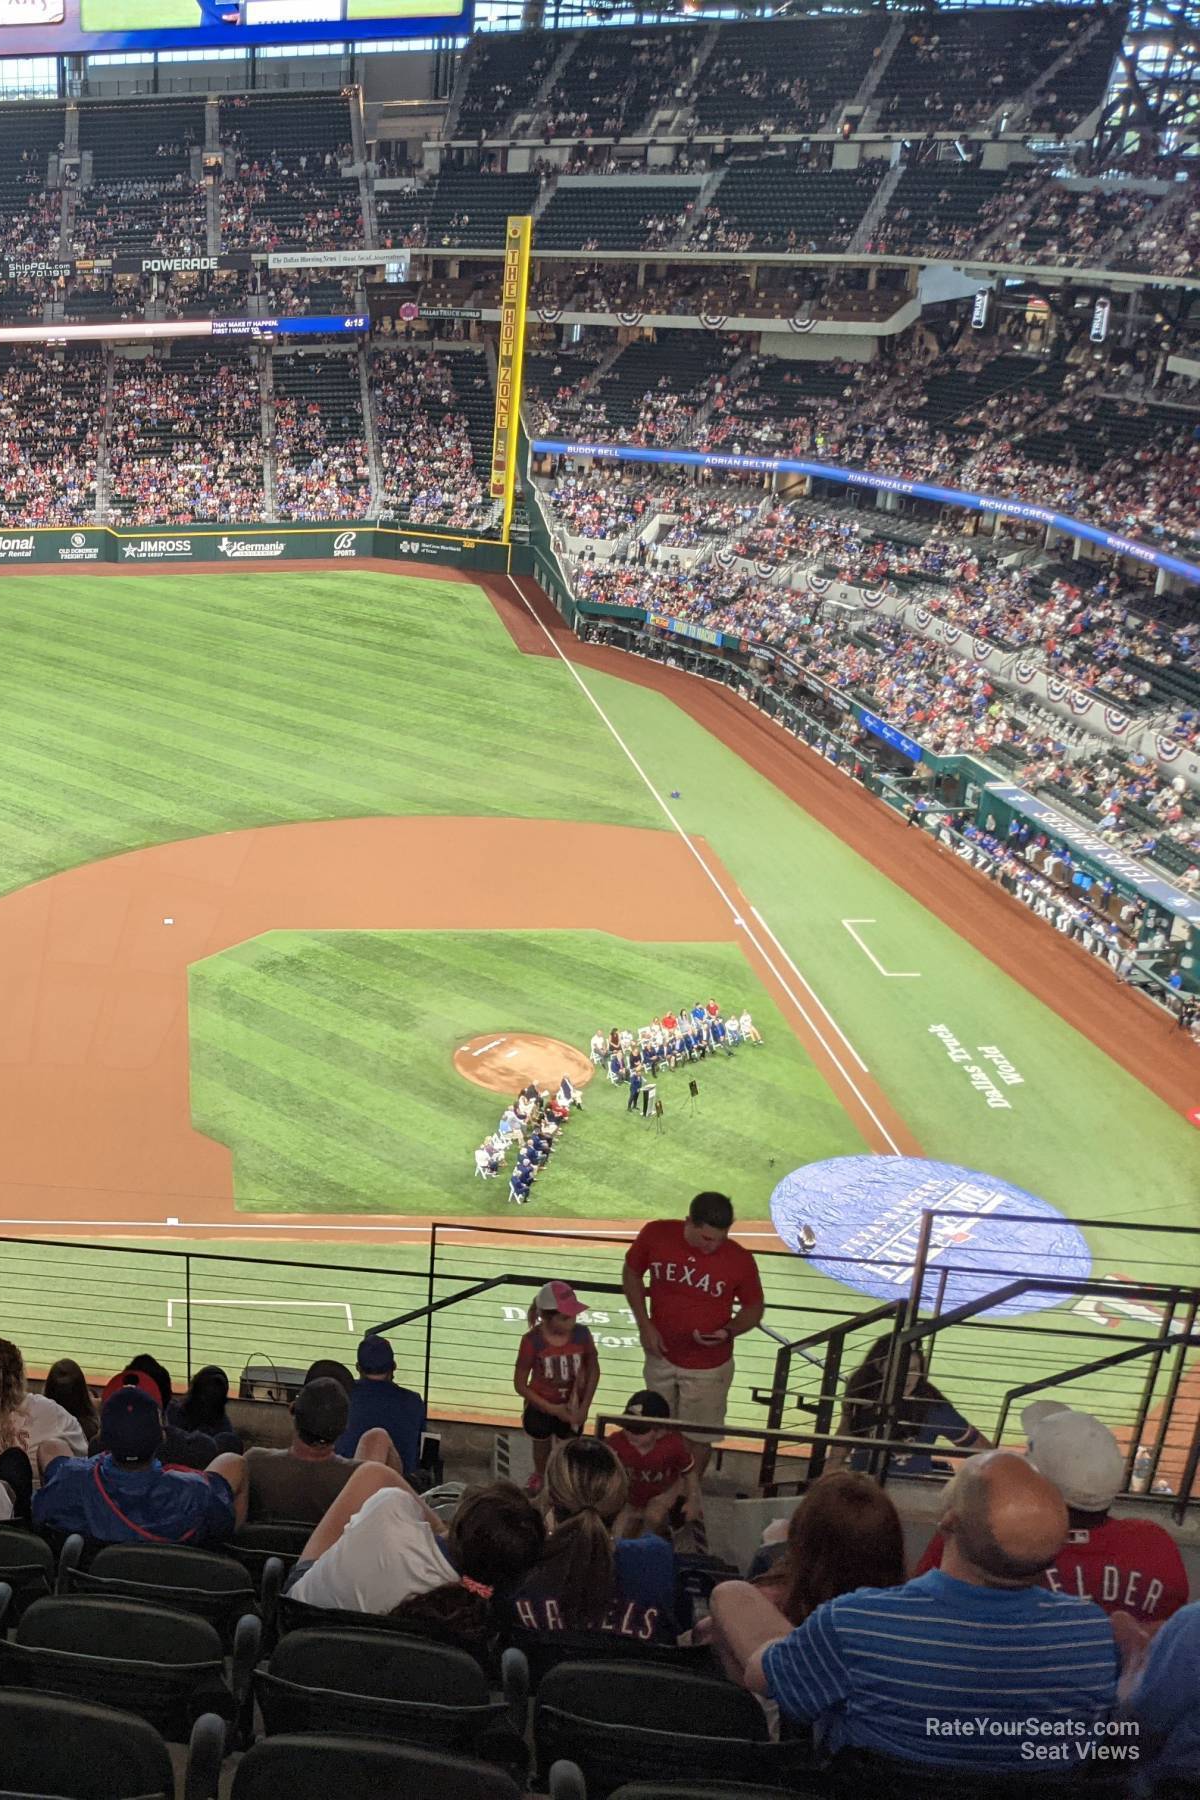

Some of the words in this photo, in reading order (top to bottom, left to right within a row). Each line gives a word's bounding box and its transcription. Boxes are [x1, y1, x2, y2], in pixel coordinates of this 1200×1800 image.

[8, 262, 71, 271] ShipPGL.com
[142, 257, 219, 272] POWERADE
[8, 269, 71, 278] 877.701.1919
[506, 250, 519, 297] THE
[344, 318, 364, 327] 6:15
[502, 309, 515, 355] HOT
[498, 368, 511, 428] ZONE
[567, 446, 597, 456] BUDDY
[598, 447, 620, 457] BELL
[705, 456, 741, 468] ADRIAN
[742, 459, 779, 471] BELTRE
[847, 474, 867, 486] JUAN
[979, 499, 1021, 515] RICHARD
[237, 541, 286, 551] Germania
[1106, 536, 1129, 552] RUSTY
[8, 550, 32, 558] Rental
[333, 549, 356, 557] SPORTS
[1033, 811, 1108, 851] RANGERS
[1097, 852, 1159, 884] TEXAS
[927, 1023, 972, 1063] Truck
[976, 1046, 1025, 1086] World
[963, 1065, 1012, 1109] Dallas
[651, 1261, 727, 1298] TEXAS
